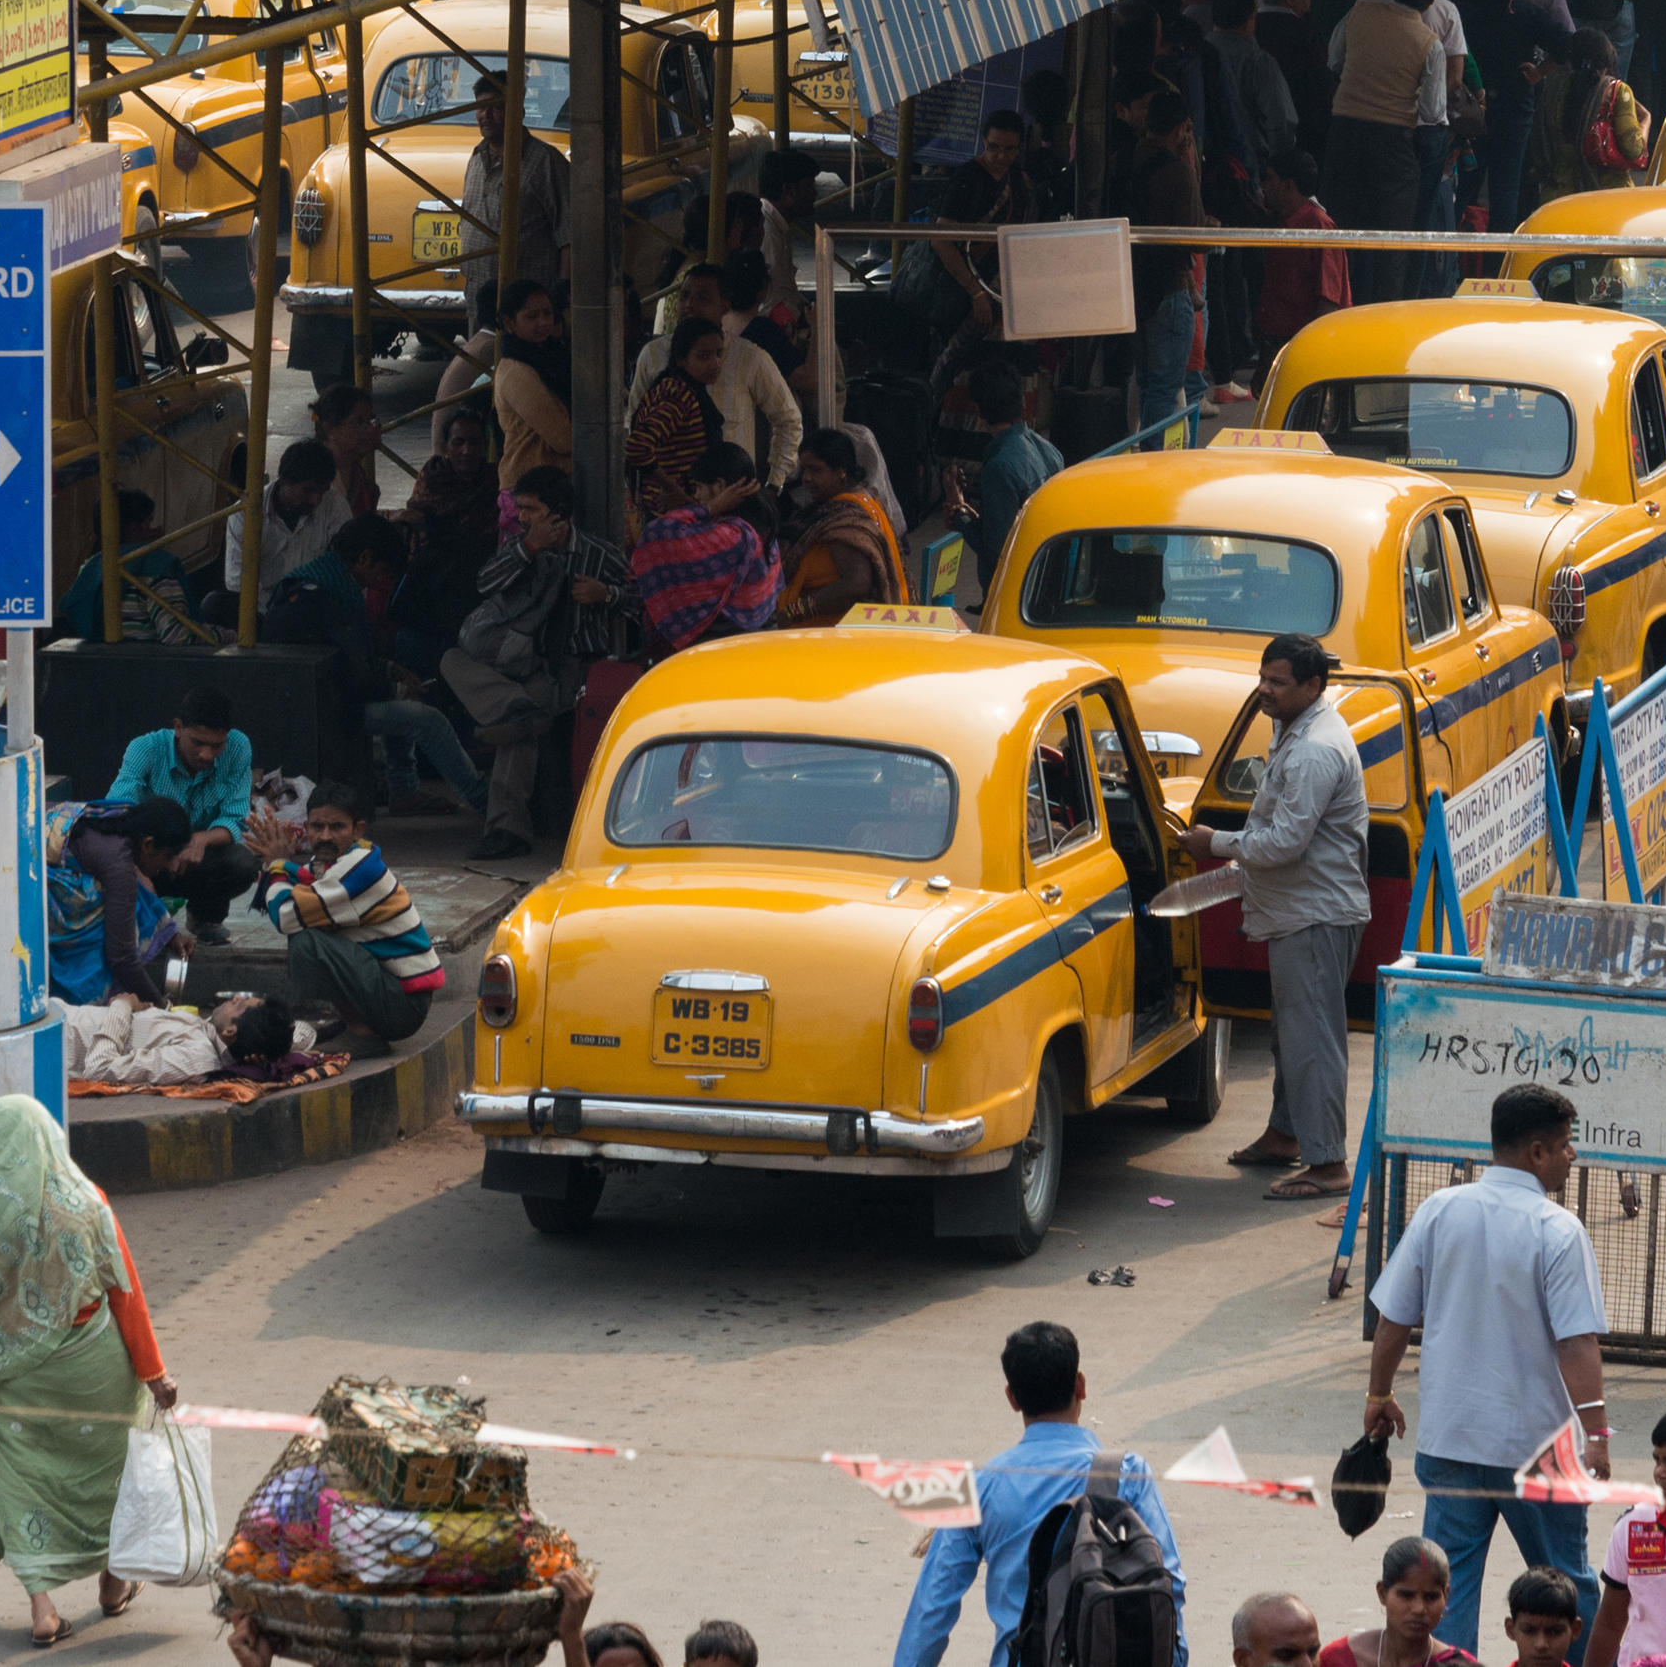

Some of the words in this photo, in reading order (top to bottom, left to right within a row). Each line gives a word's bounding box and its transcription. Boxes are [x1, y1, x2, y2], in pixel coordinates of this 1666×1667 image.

[1231, 429, 1304, 449] TAXI
[862, 607, 938, 625] TAXI
[1499, 906, 1633, 975] HOWRAH
[1584, 1120, 1643, 1150] Infra
